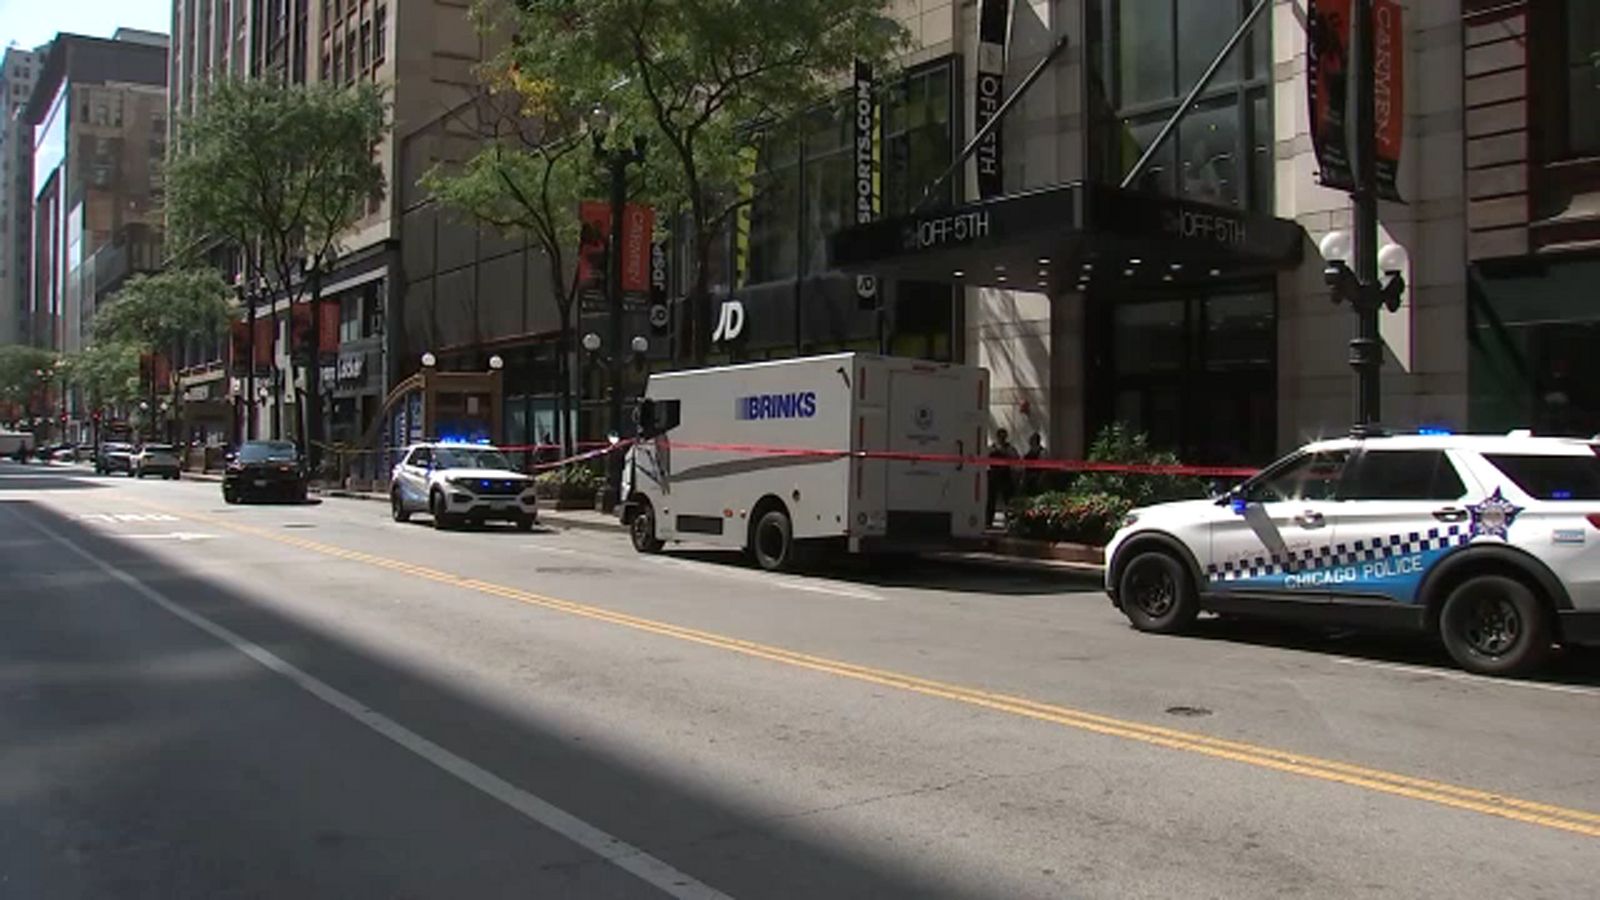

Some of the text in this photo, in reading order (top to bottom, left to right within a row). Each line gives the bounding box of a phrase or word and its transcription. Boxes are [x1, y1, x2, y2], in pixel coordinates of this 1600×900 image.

[1375, 7, 1391, 146] CARMEN
[856, 80, 872, 224] SPORTS.COM
[712, 300, 745, 344] JD
[749, 392, 816, 420] BRINKS
[1283, 554, 1425, 590] CHICAGO POLICE
